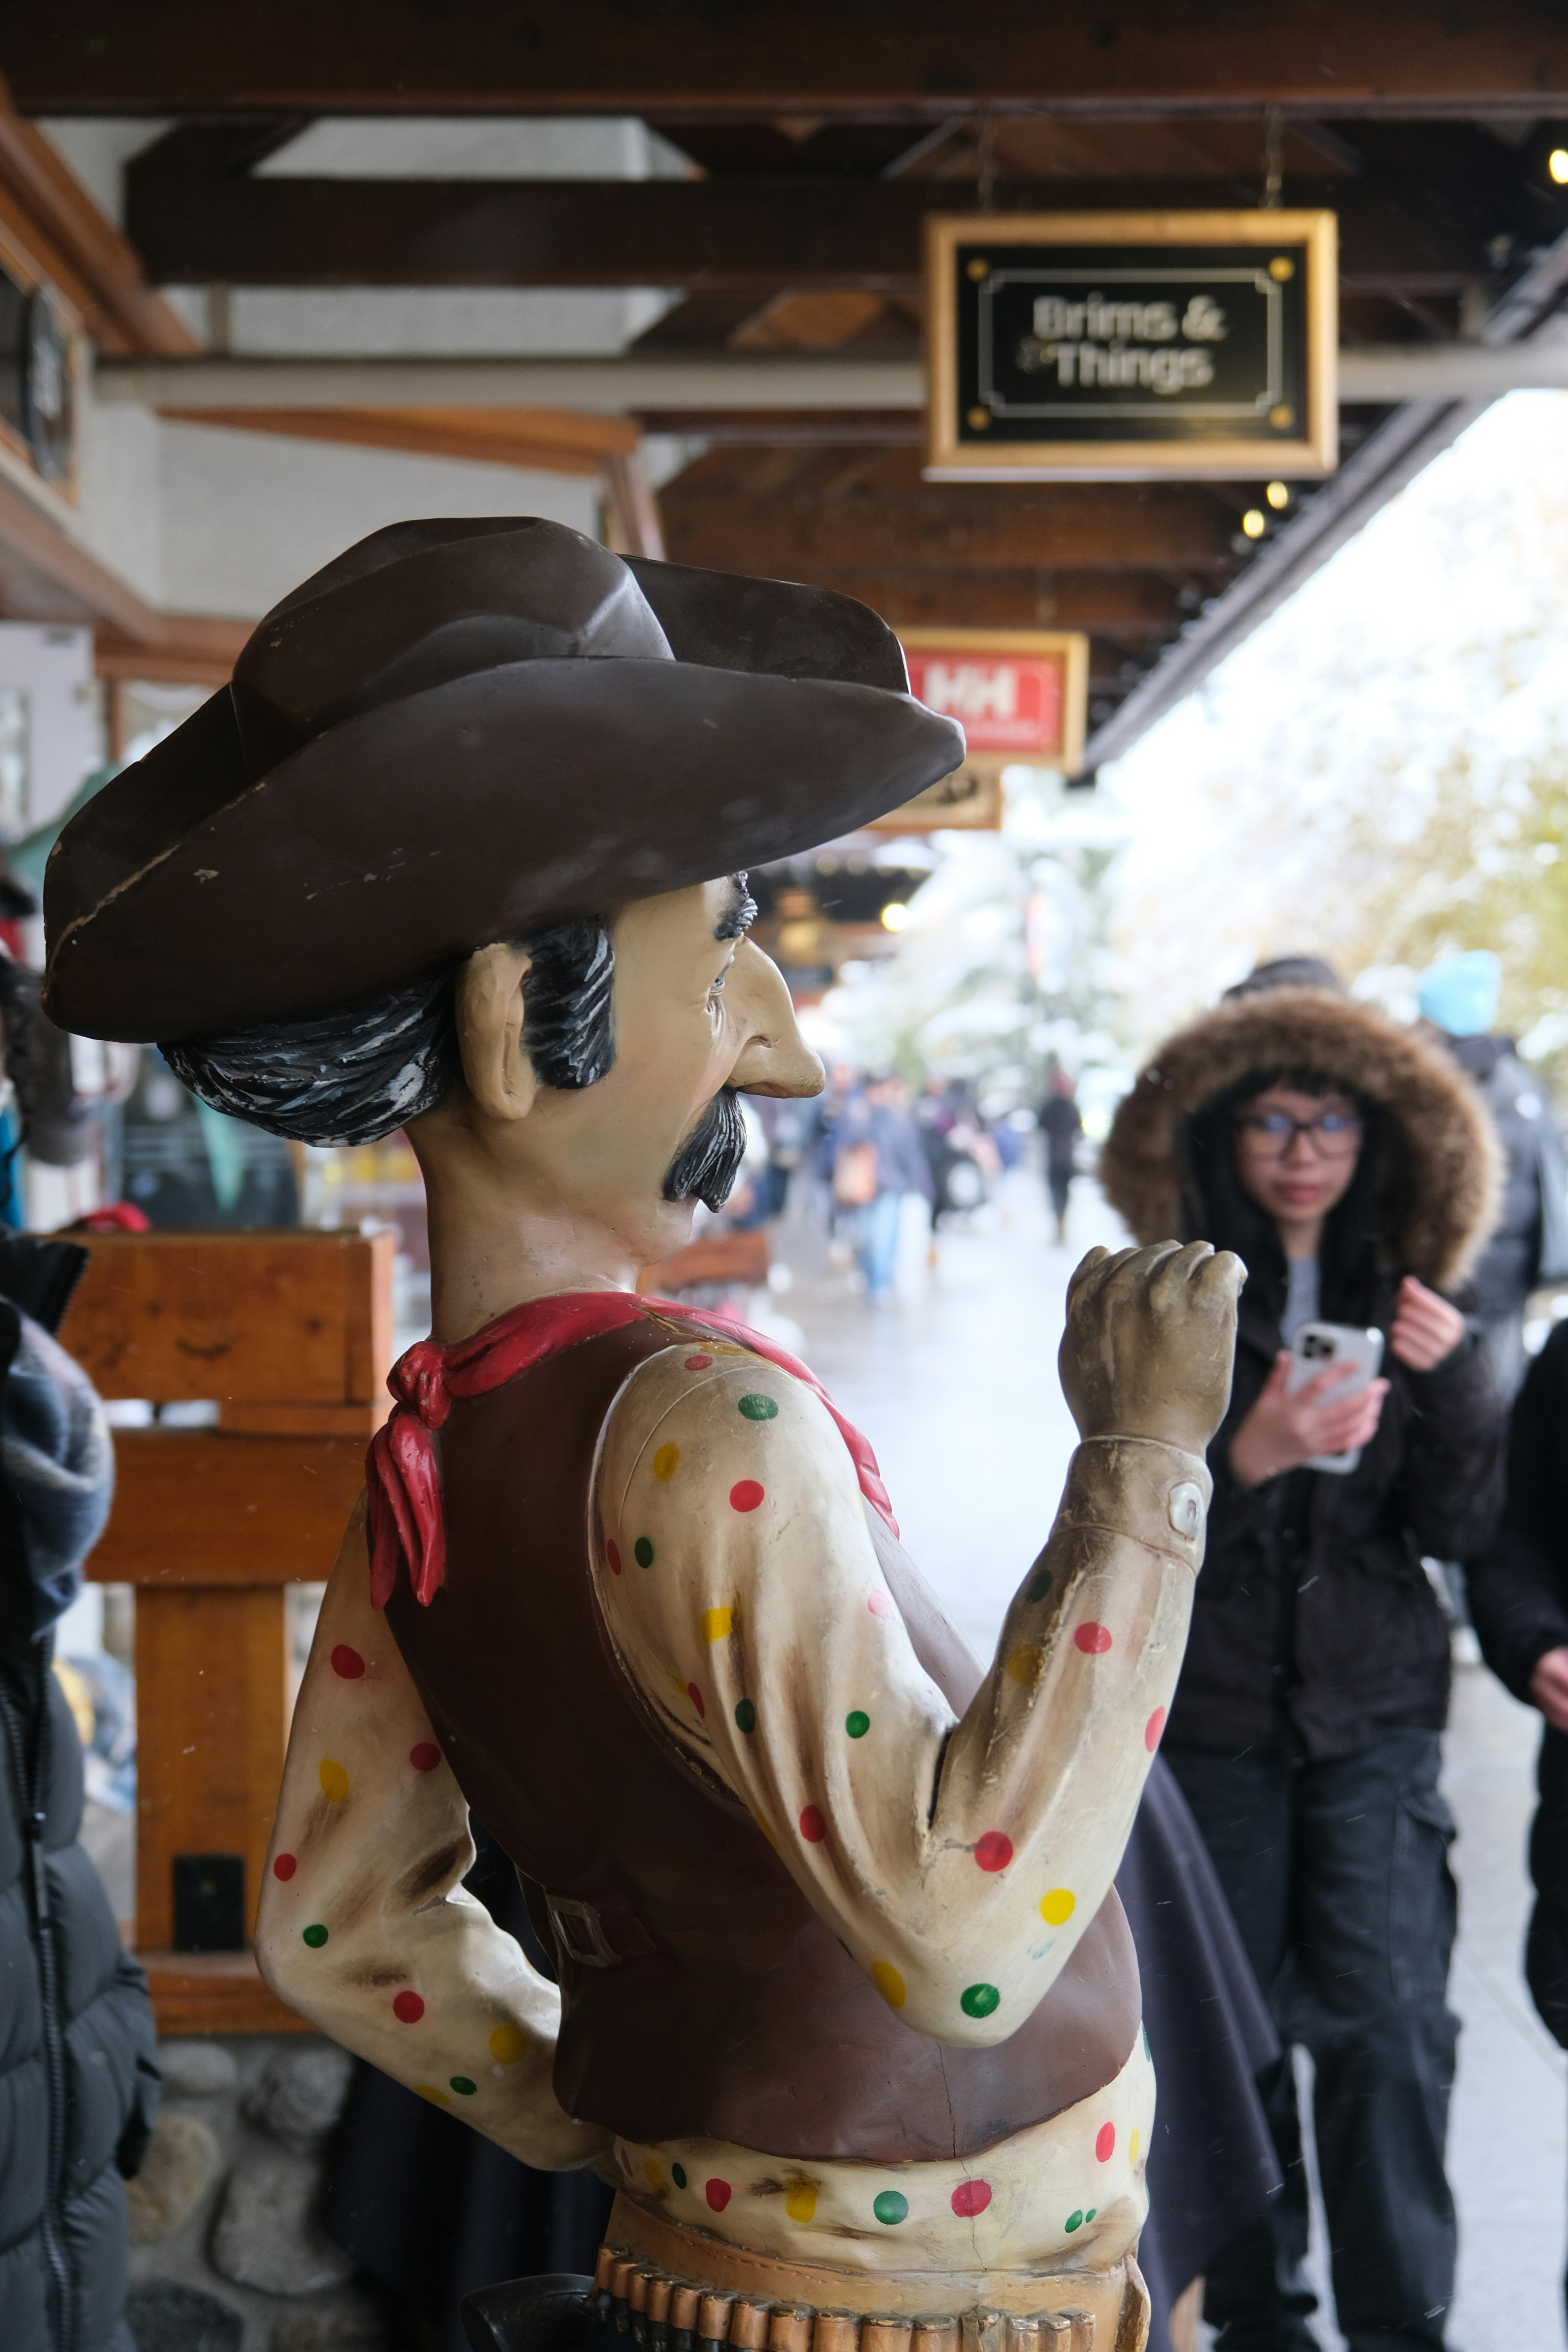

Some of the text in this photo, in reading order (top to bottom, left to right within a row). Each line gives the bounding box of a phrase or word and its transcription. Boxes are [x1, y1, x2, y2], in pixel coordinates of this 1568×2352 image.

[1034, 293, 1227, 341] Brims &
[1049, 339, 1213, 394] Things
